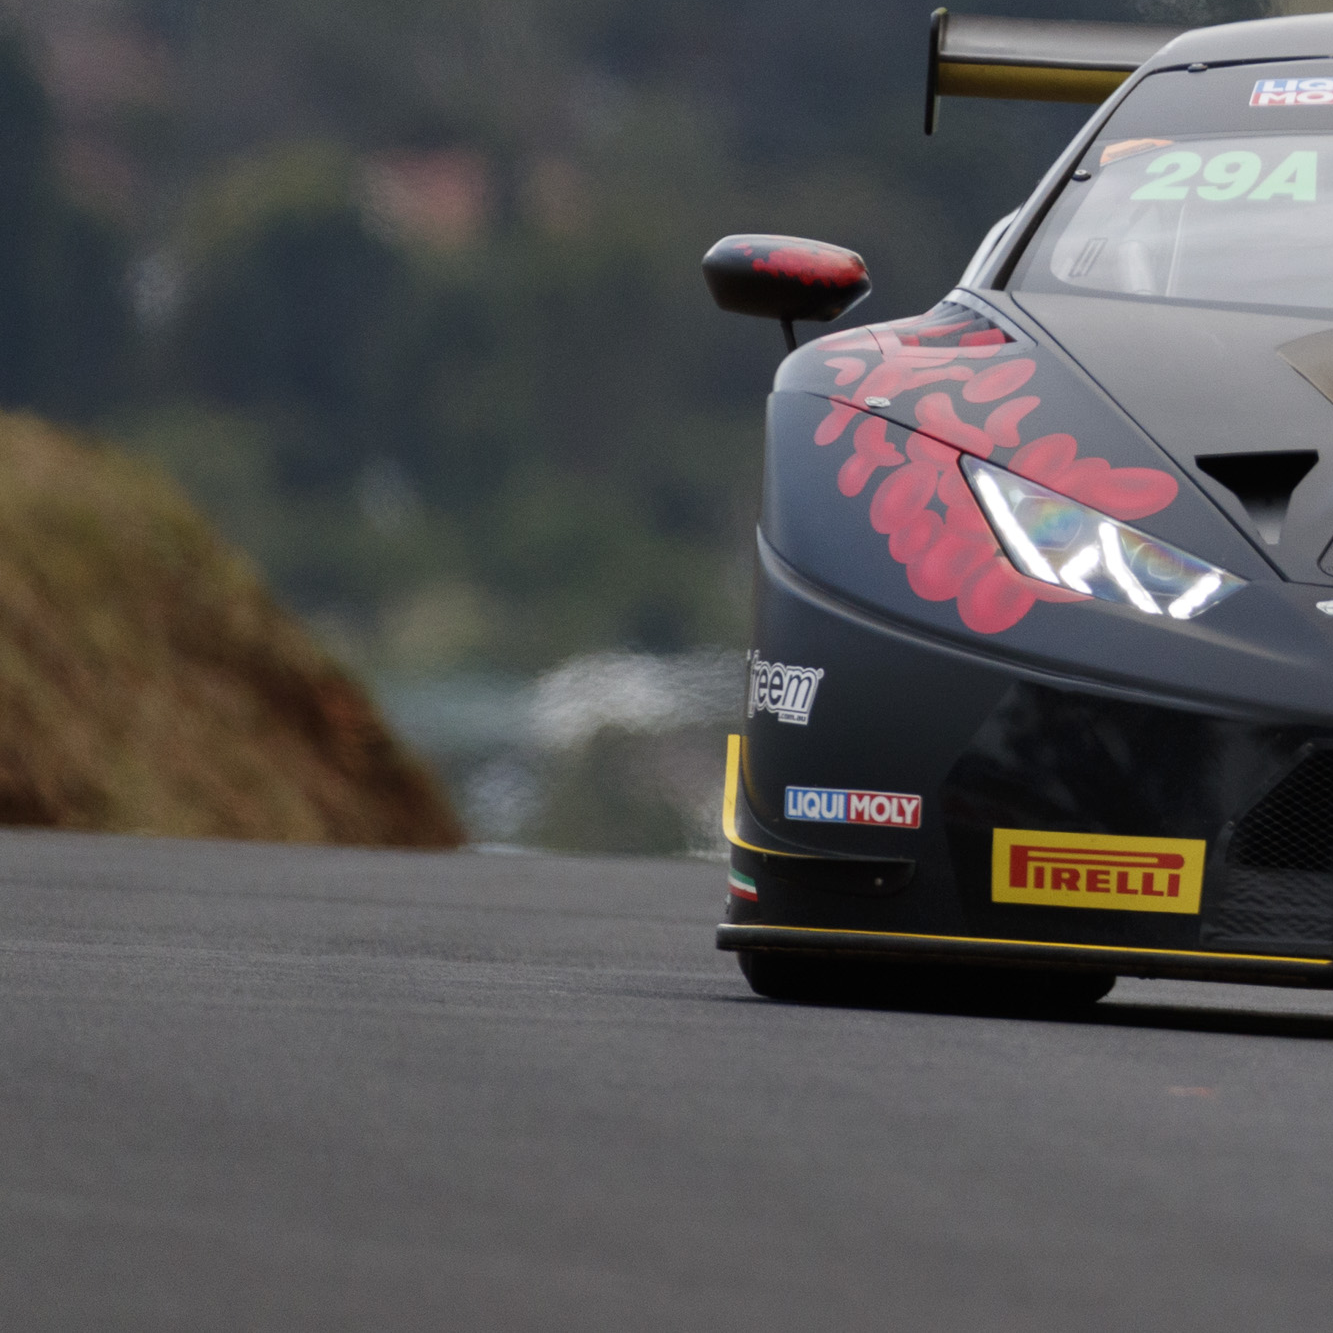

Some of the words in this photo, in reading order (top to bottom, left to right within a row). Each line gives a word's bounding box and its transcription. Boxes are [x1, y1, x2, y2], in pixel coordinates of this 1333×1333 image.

[1129, 150, 1319, 202] 29A
[787, 790, 846, 820] LIQUI
[849, 793, 919, 825] MOLY
[1008, 844, 1186, 898] PIRELLI
